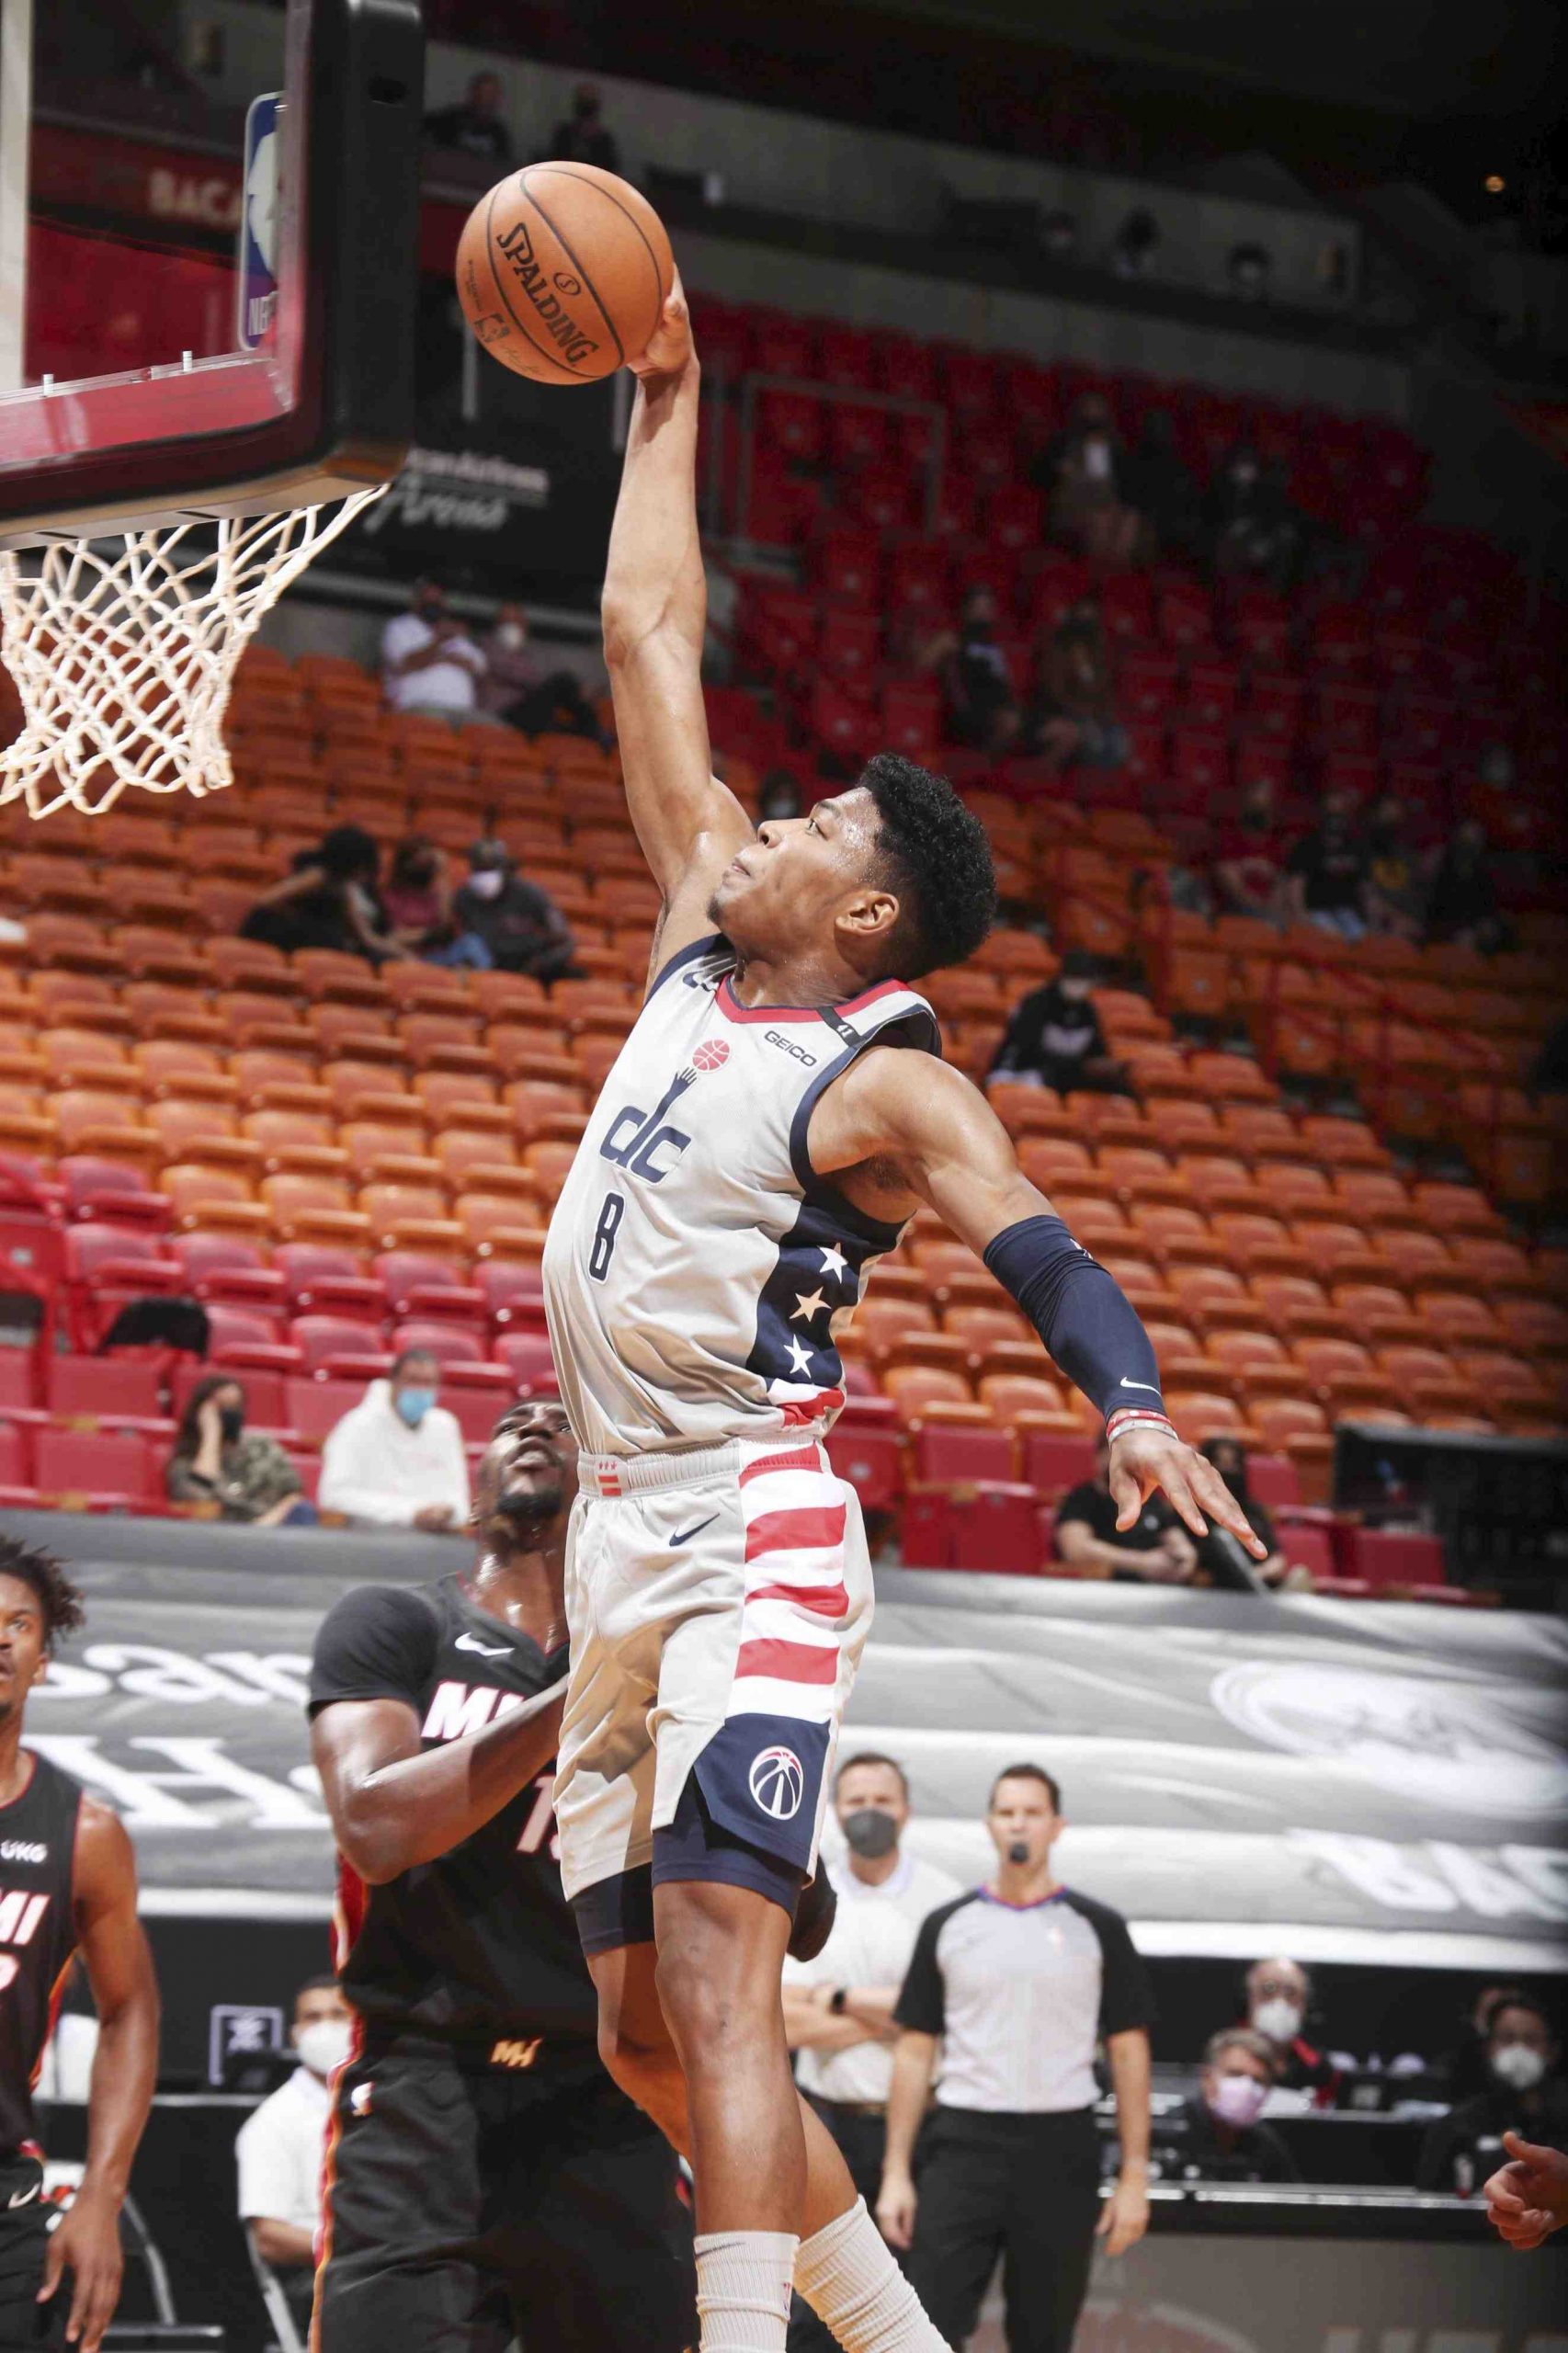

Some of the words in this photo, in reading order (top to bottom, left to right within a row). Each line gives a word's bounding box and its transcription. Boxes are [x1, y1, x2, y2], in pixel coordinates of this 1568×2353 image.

[496, 222, 600, 363] SPALDING
[764, 1029, 818, 1067] GEICO
[599, 1069, 698, 1184] dc
[588, 1192, 625, 1281] 8
[0, 1839, 48, 1863] UKG
[517, 1775, 561, 1860] 1
